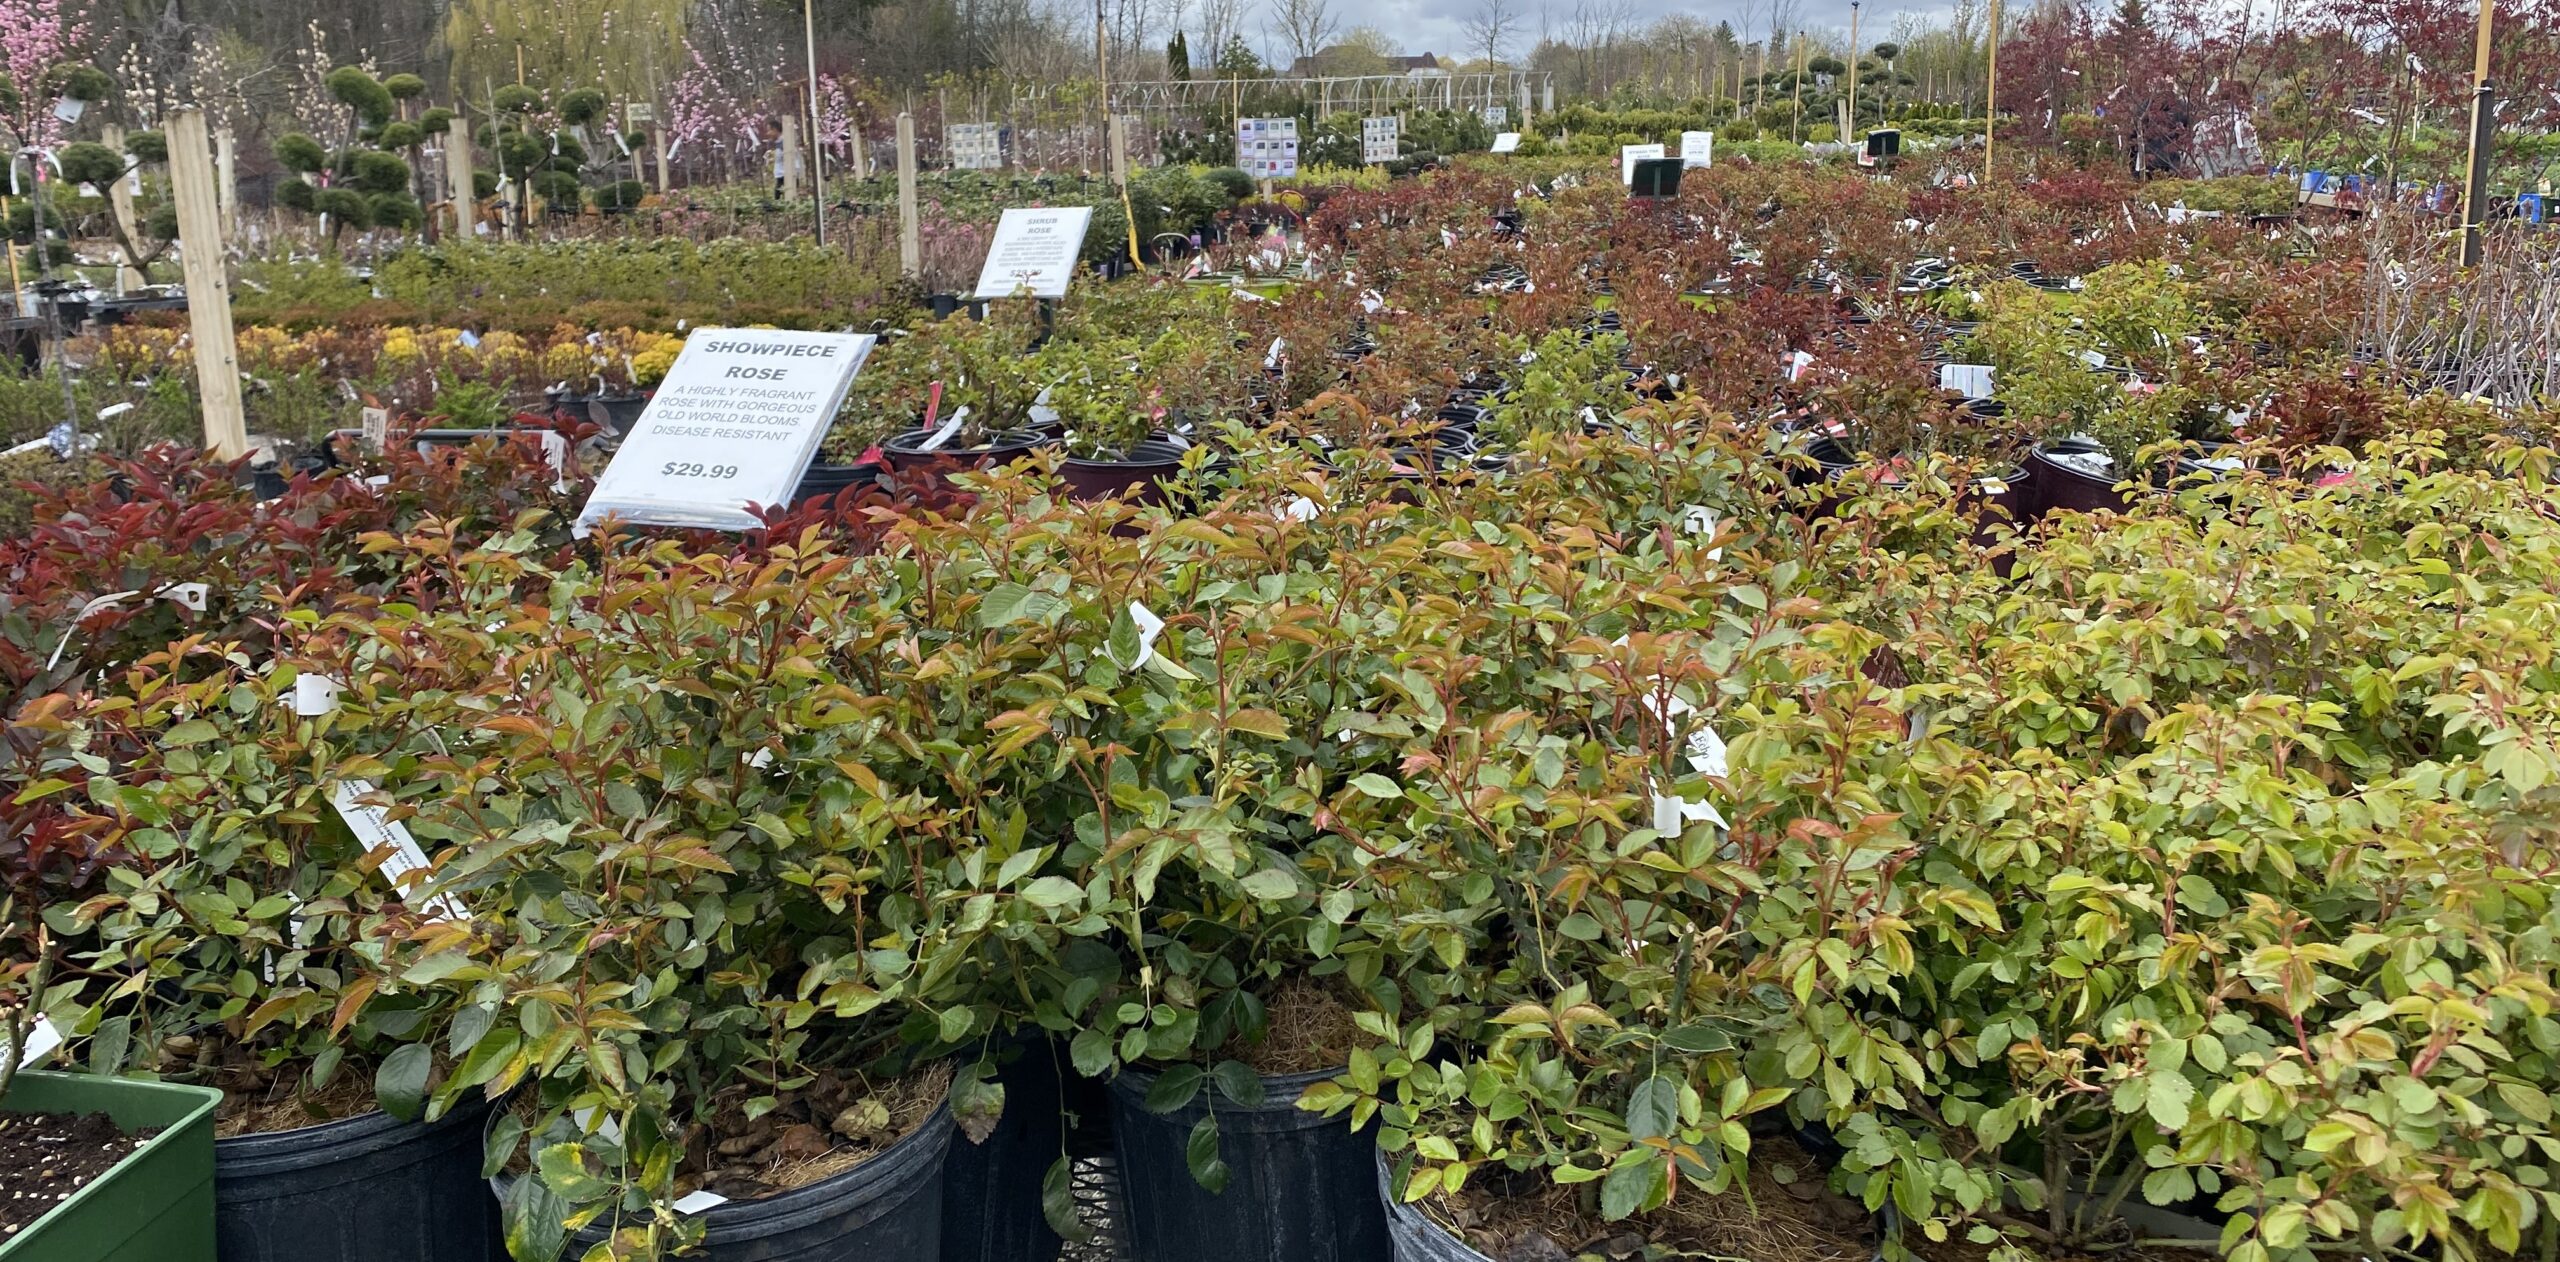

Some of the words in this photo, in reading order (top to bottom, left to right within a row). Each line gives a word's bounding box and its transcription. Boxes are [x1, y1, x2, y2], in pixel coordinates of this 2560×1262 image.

[705, 341, 837, 358] SHOWPIECE
[724, 366, 788, 381] ROSE
[675, 385, 685, 394] A
[687, 386, 739, 397] HIGHLY
[740, 388, 816, 401] FRAGRANT
[658, 397, 697, 408] ROSE
[700, 399, 734, 409] WITH
[737, 401, 817, 414] GORGEOUS
[657, 410, 685, 420] OLD
[688, 411, 738, 423] WORLD
[652, 425, 711, 438] DISEASE
[713, 427, 792, 442] RESISTANT
[661, 462, 738, 480] $29.99
